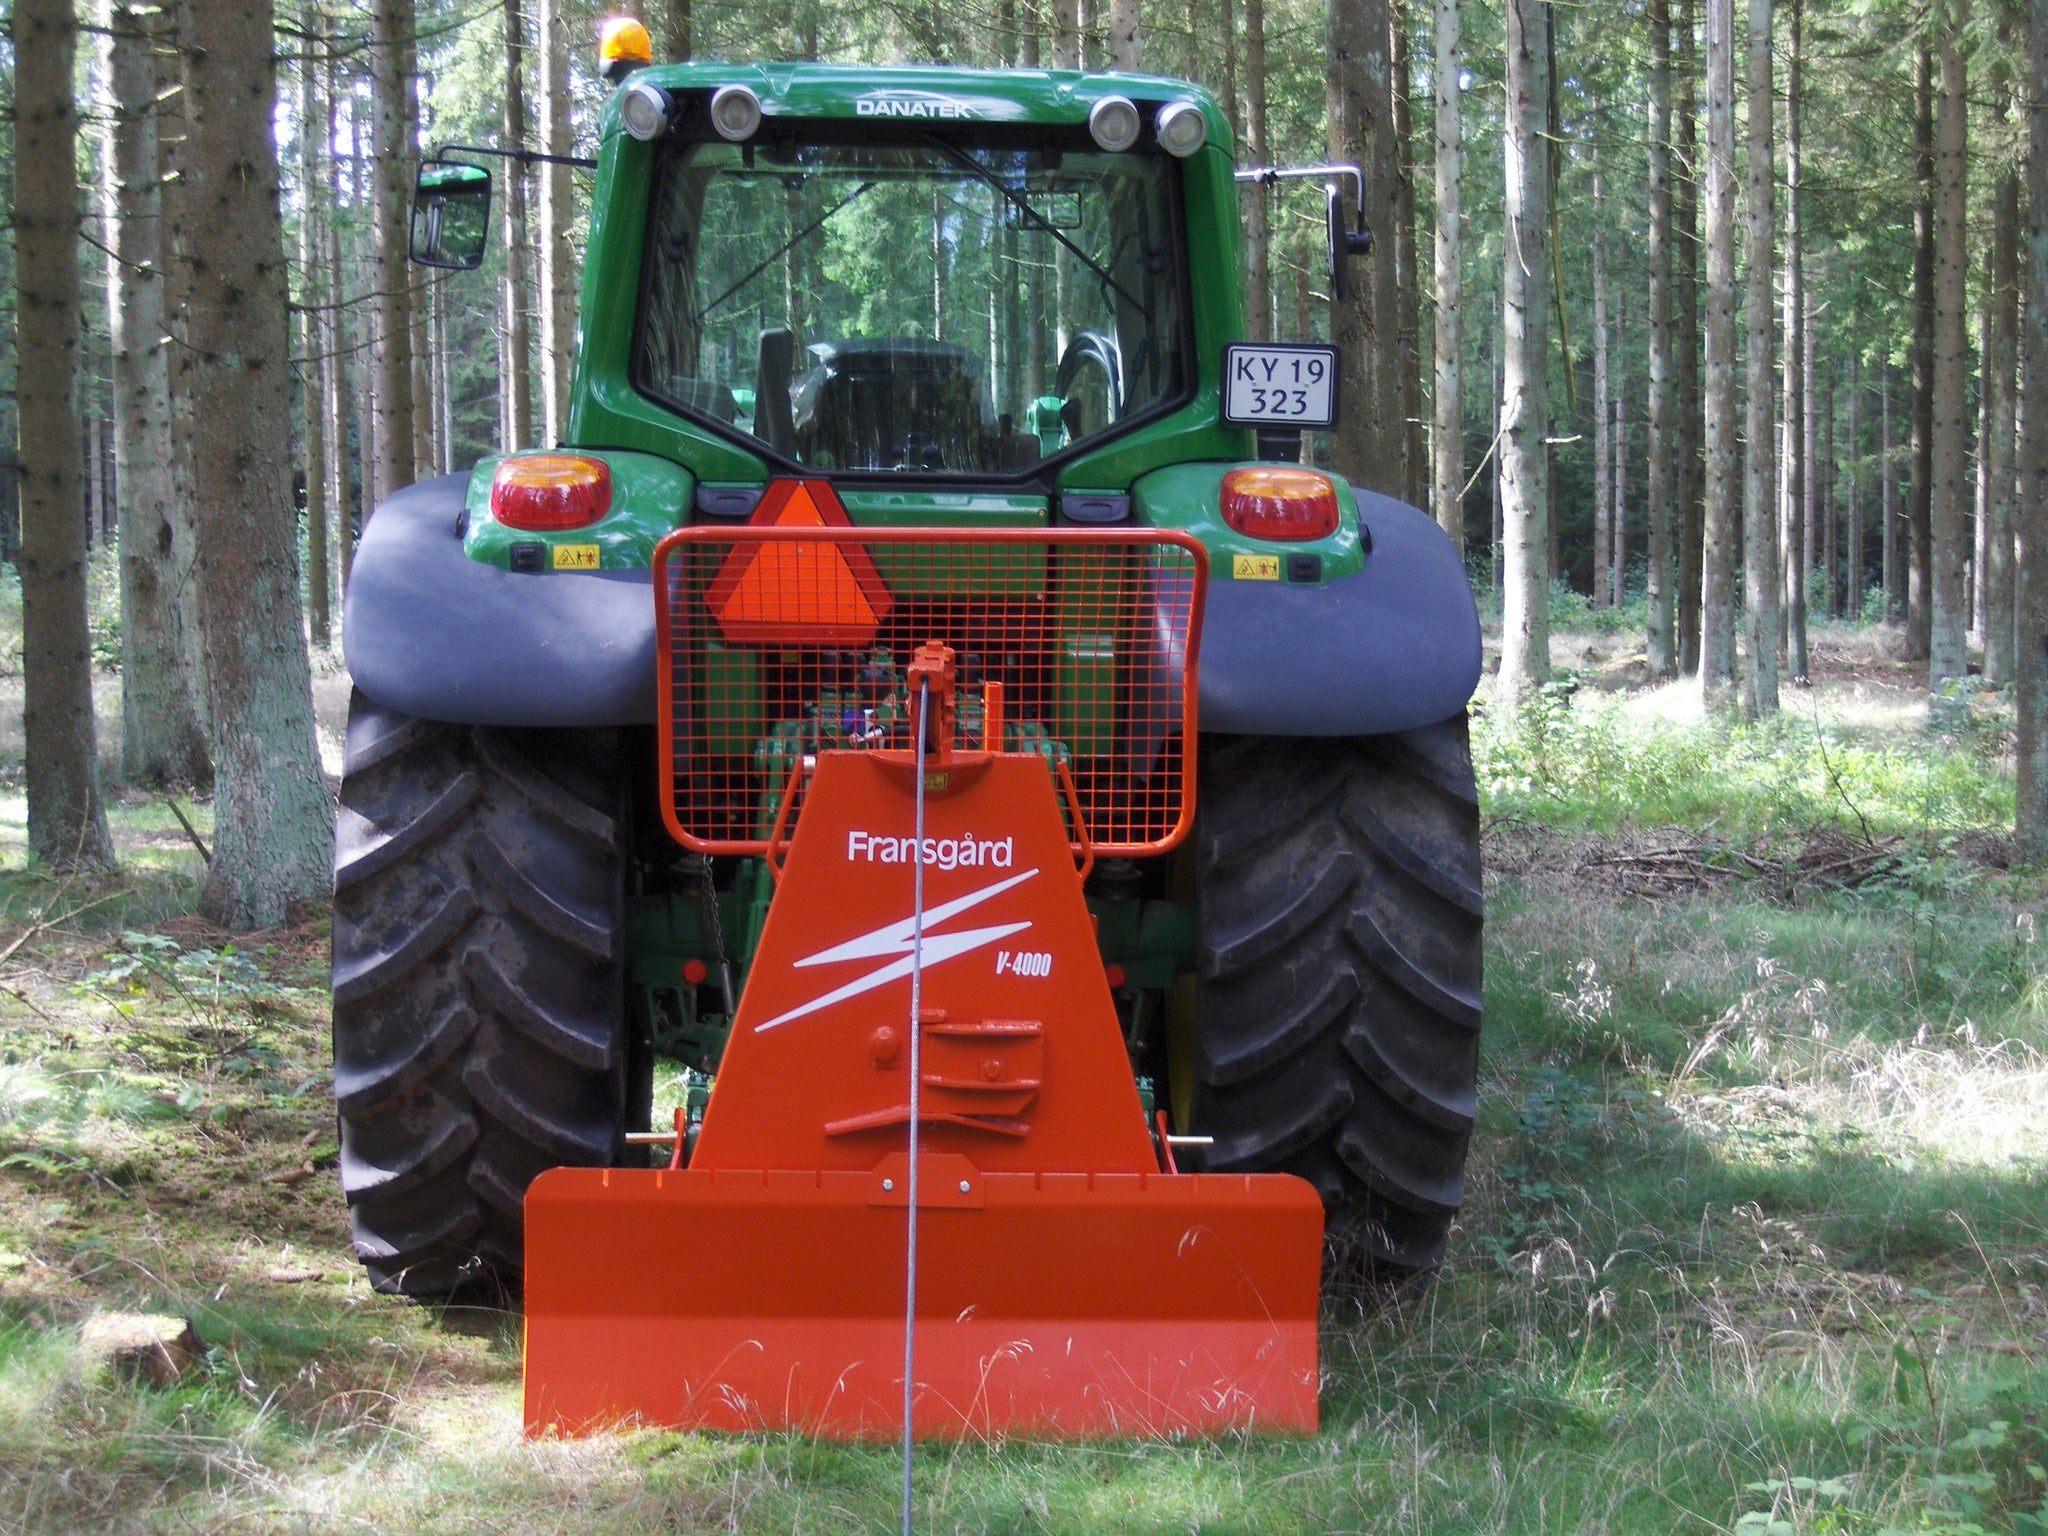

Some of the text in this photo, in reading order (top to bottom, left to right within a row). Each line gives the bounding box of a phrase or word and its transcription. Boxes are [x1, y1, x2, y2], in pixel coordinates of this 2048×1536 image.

[856, 100, 971, 118] DANATEK
[1237, 356, 1324, 385] KY 19
[1250, 389, 1307, 415] 323
[848, 831, 1013, 870] Fransgård
[996, 950, 1052, 977] V-4000
